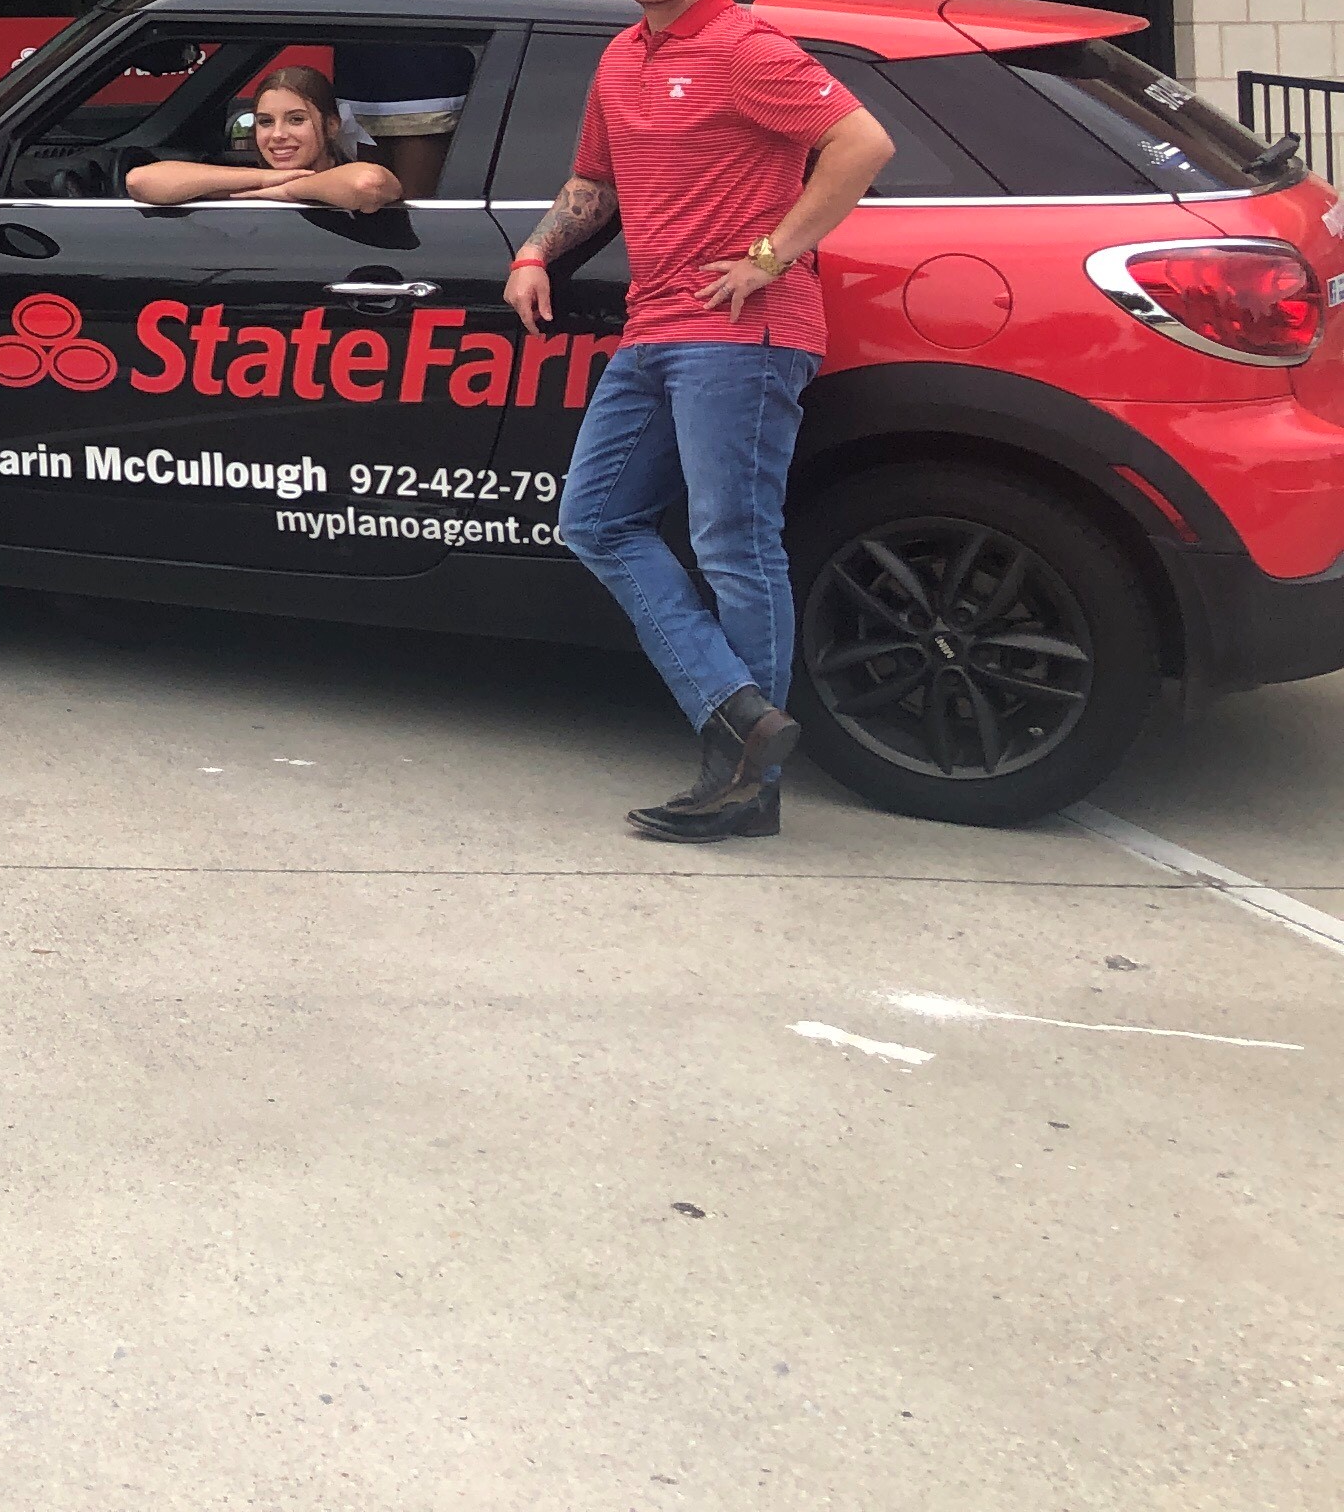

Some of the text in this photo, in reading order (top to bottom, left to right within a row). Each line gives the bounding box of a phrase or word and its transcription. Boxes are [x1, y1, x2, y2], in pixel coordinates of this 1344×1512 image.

[84, 445, 327, 497] McCullough
[349, 463, 568, 503] 972-422-79
[276, 506, 568, 548] myplanoagent.c
